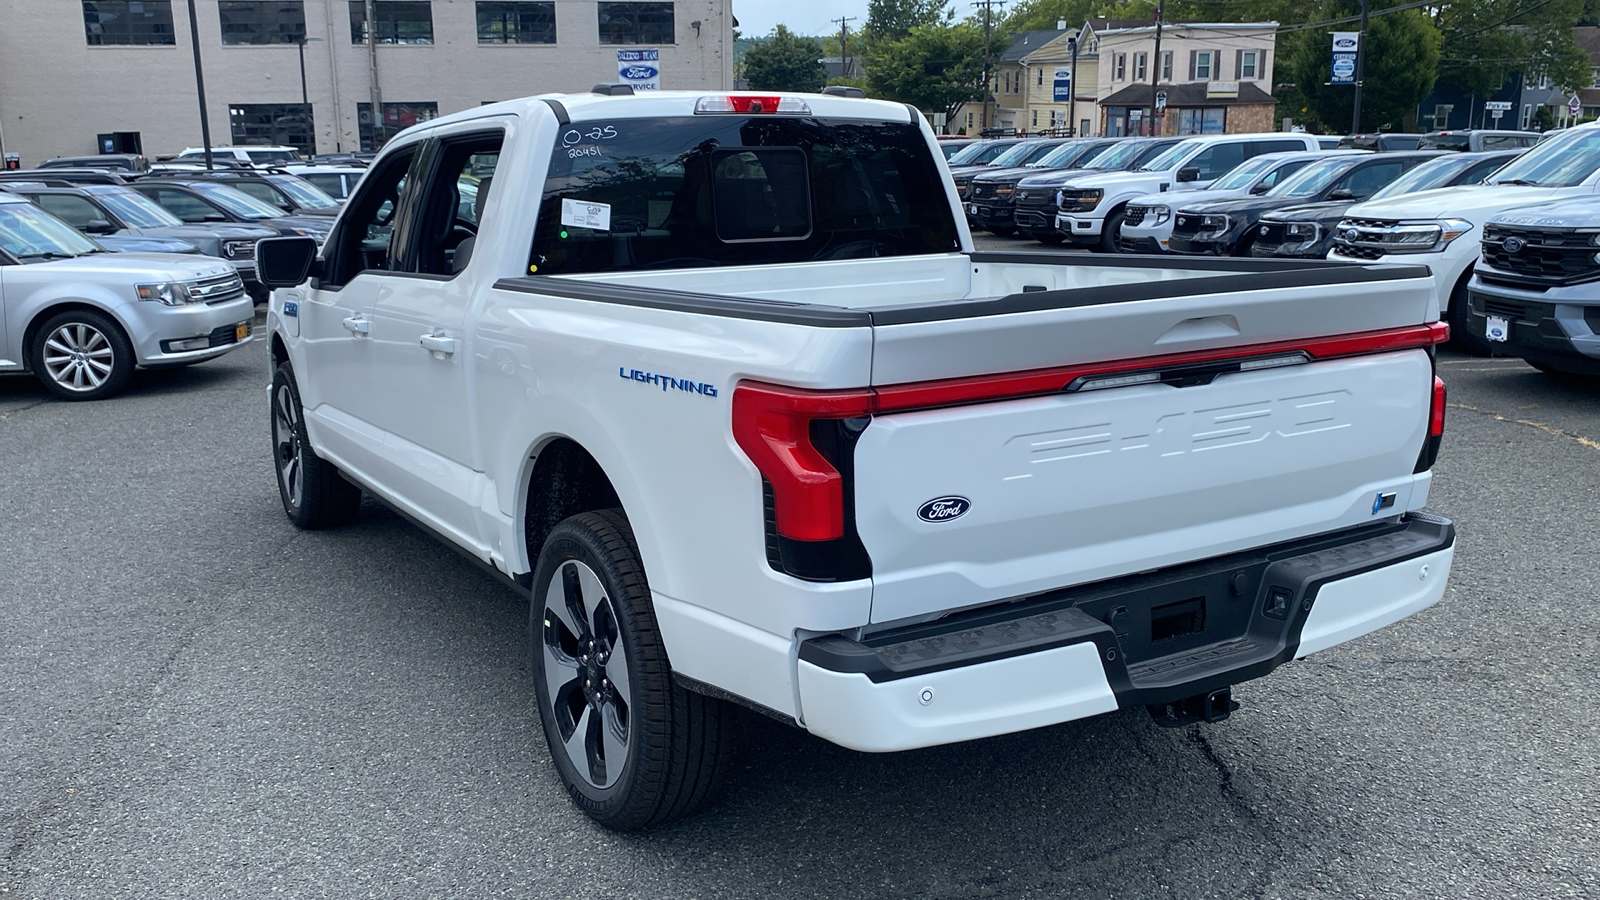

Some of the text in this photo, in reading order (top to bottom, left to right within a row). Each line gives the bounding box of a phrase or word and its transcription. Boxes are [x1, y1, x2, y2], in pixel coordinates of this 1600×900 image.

[627, 67, 652, 78] Ford
[619, 367, 718, 398] LIGHTNING
[928, 500, 963, 519] Ford
